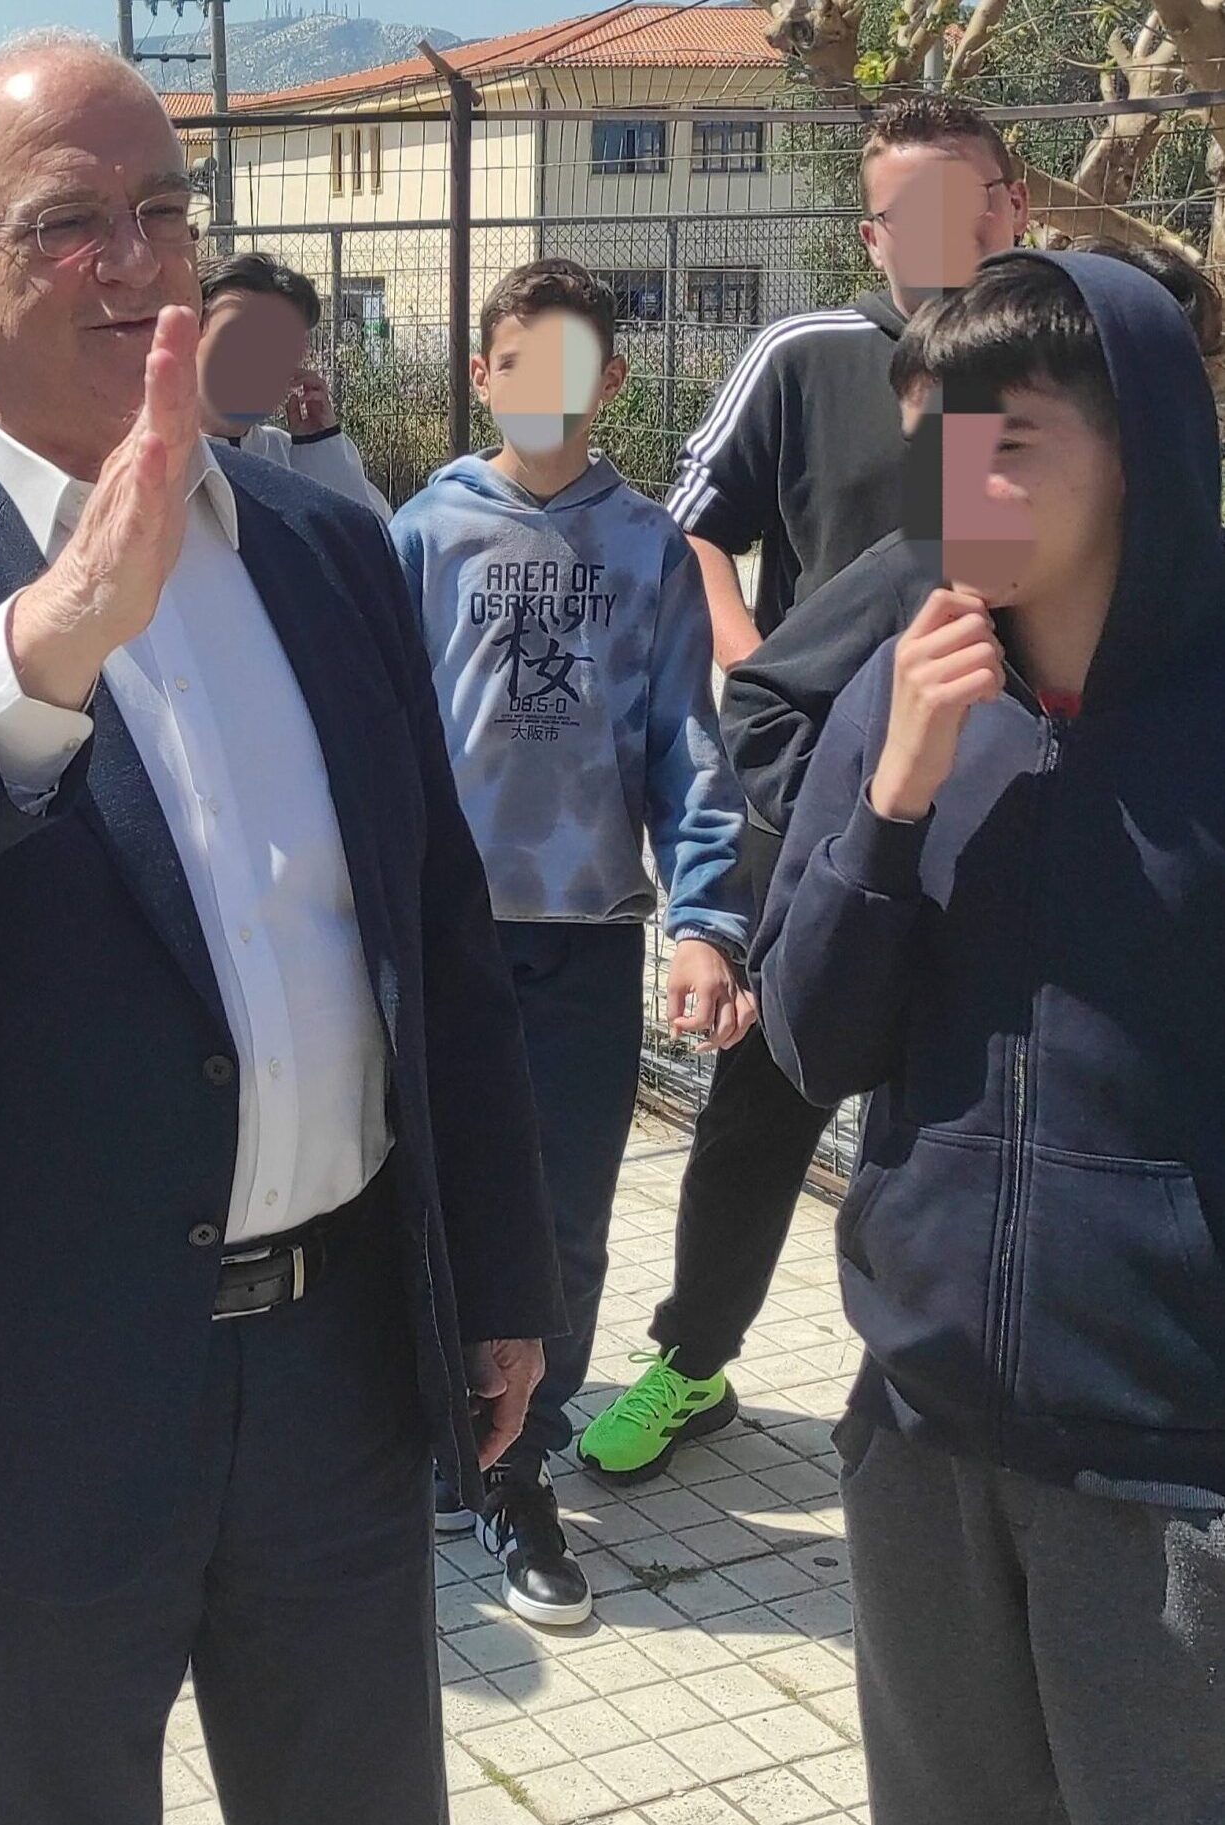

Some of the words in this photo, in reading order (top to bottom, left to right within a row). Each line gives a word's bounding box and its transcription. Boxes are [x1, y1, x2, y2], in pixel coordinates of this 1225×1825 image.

[486, 561, 559, 592] AREA
[571, 562, 605, 592] OF
[470, 592, 559, 625] OSAKA
[563, 593, 617, 627] CITY
[510, 724, 561, 742] 大阪市
